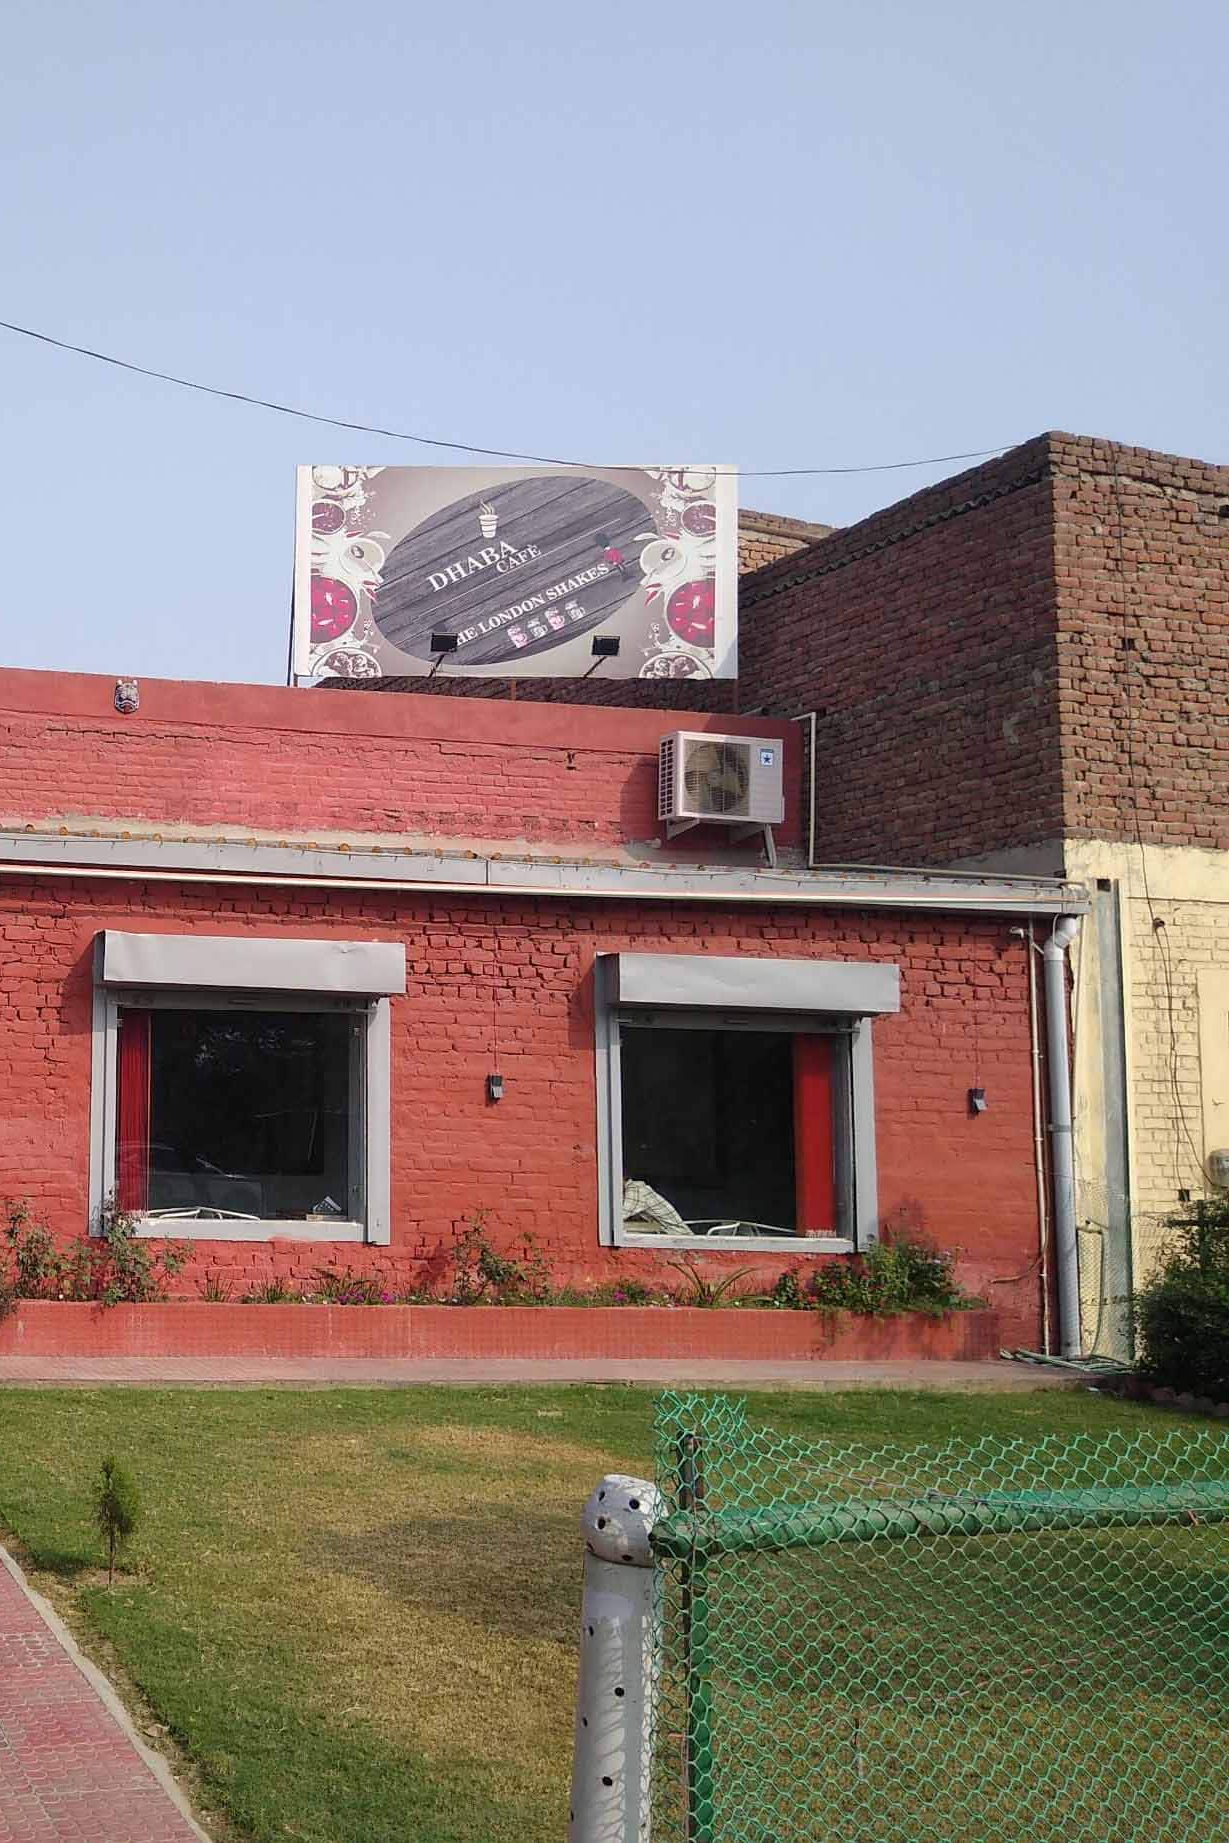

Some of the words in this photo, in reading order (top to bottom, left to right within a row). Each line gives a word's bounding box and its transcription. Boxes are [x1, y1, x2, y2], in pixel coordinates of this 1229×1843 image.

[426, 540, 519, 592] DHABA
[456, 626, 479, 647] HE
[477, 593, 546, 634] LONDON
[545, 562, 610, 600] SHAKES
